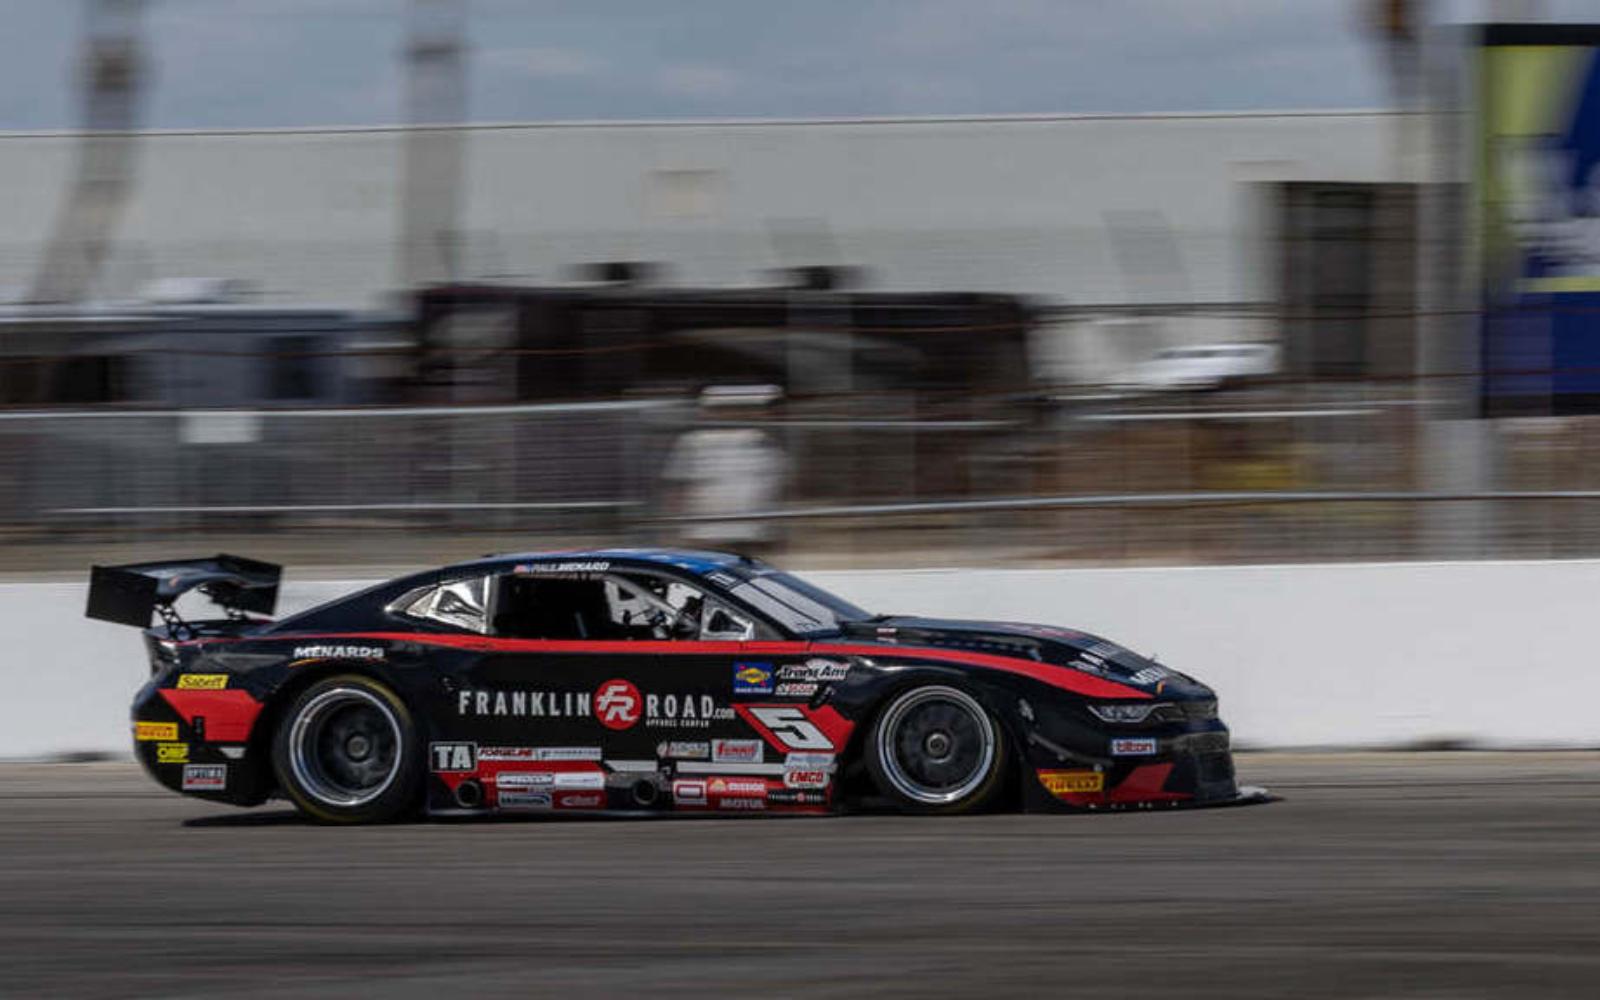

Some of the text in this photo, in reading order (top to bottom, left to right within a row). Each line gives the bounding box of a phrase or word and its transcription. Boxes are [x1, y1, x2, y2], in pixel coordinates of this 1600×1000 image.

[293, 646, 384, 659] MENARDS
[458, 691, 591, 716] FRANKLIN
[748, 708, 834, 749] 5
[434, 746, 471, 768] TA
